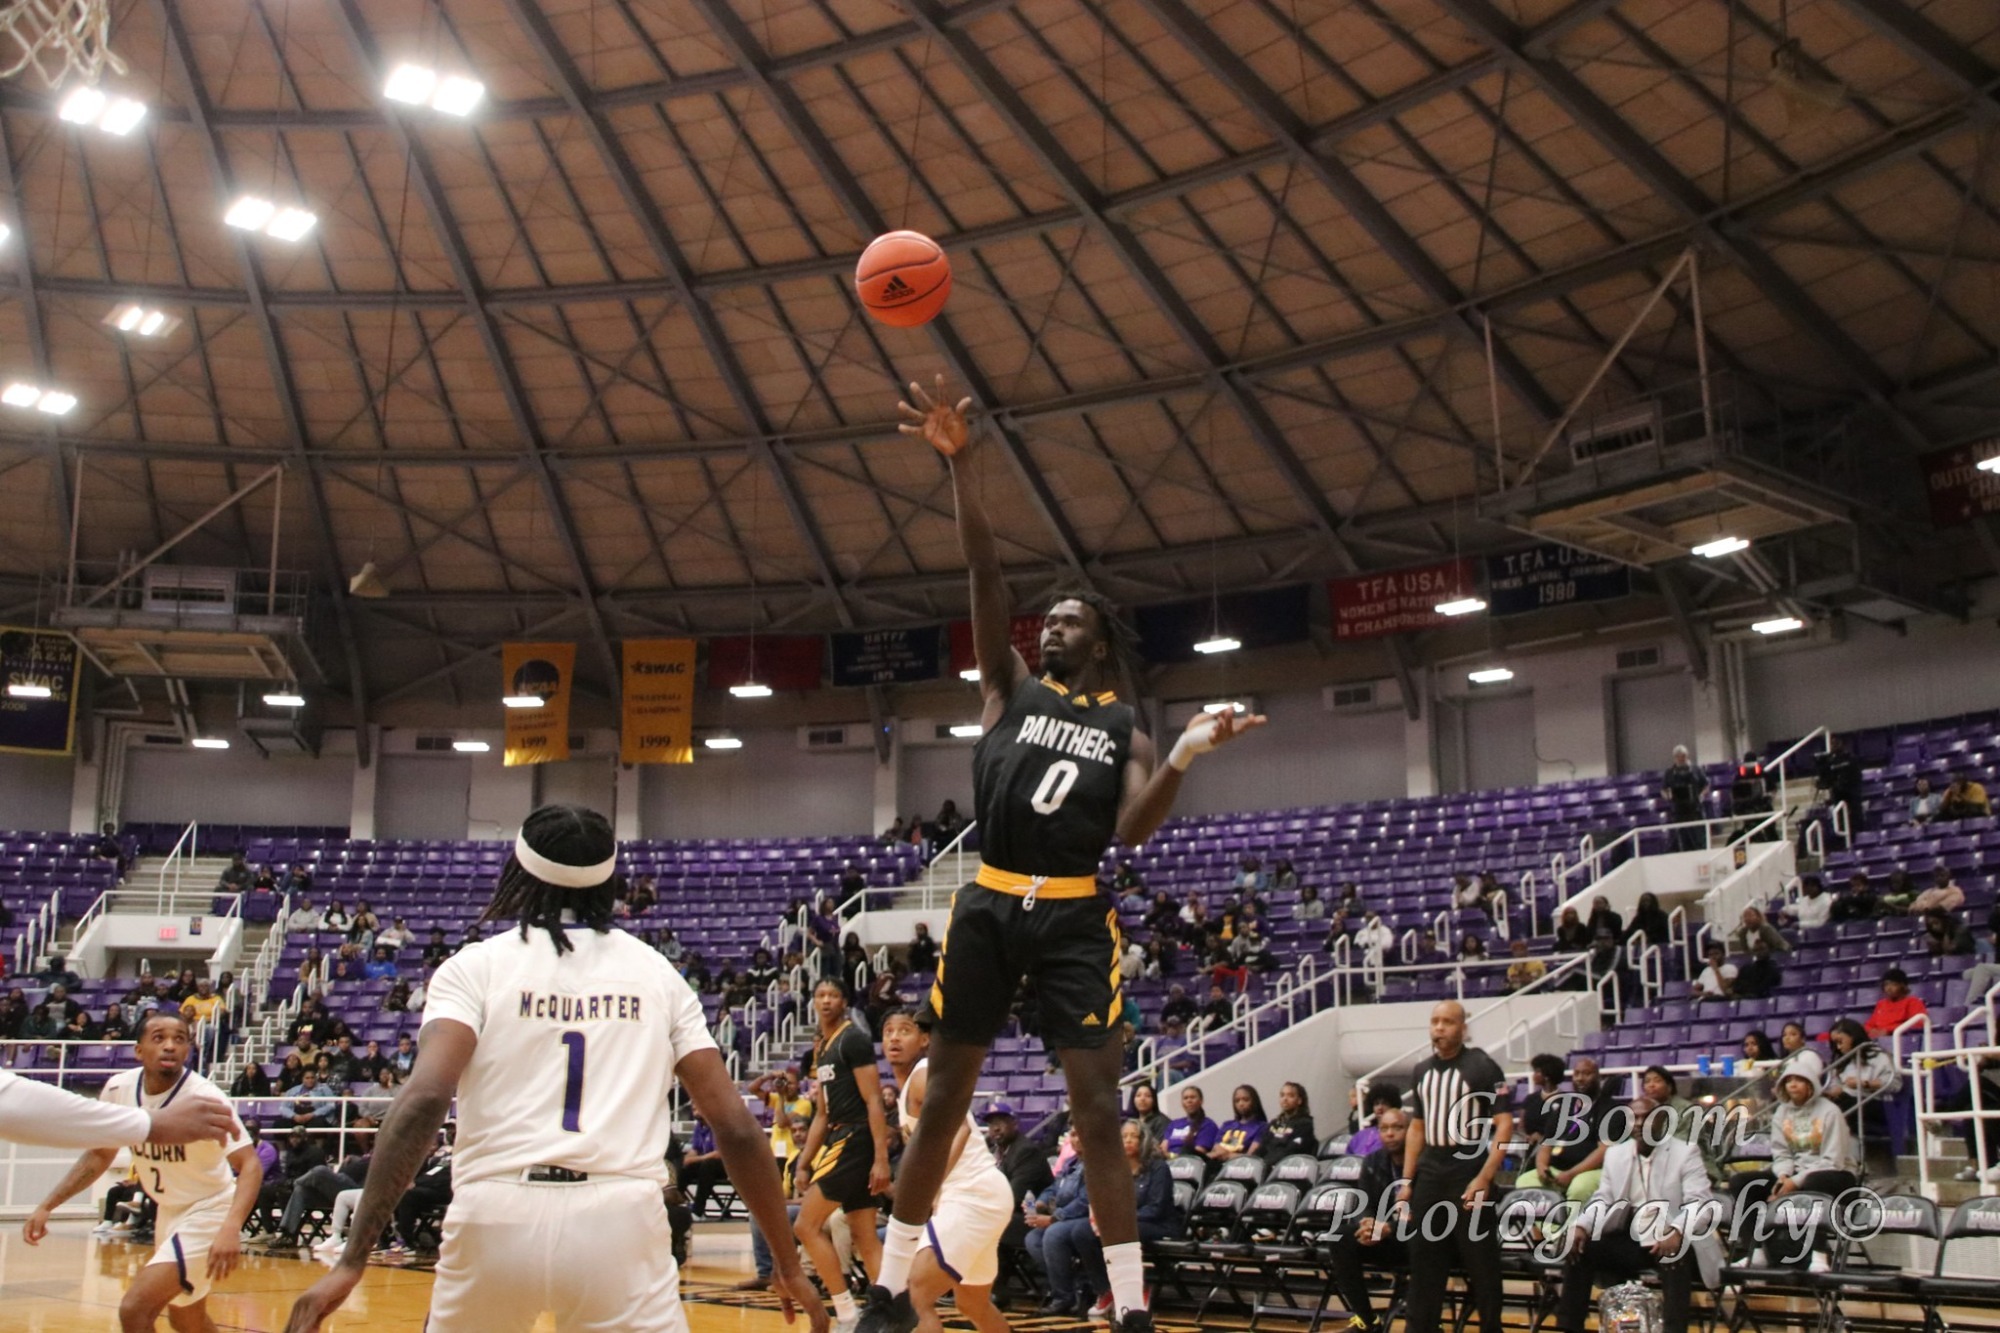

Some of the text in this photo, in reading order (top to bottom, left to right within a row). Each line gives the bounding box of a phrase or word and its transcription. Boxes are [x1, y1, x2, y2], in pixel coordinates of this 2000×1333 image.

[1399, 591, 1464, 609] NATIONA
[1539, 580, 1576, 603] 1980
[521, 736, 547, 749] 1999
[640, 736, 671, 749] 1999
[1031, 760, 1079, 815] 0
[561, 1030, 586, 1133] 1
[150, 1167, 165, 1193] 2
